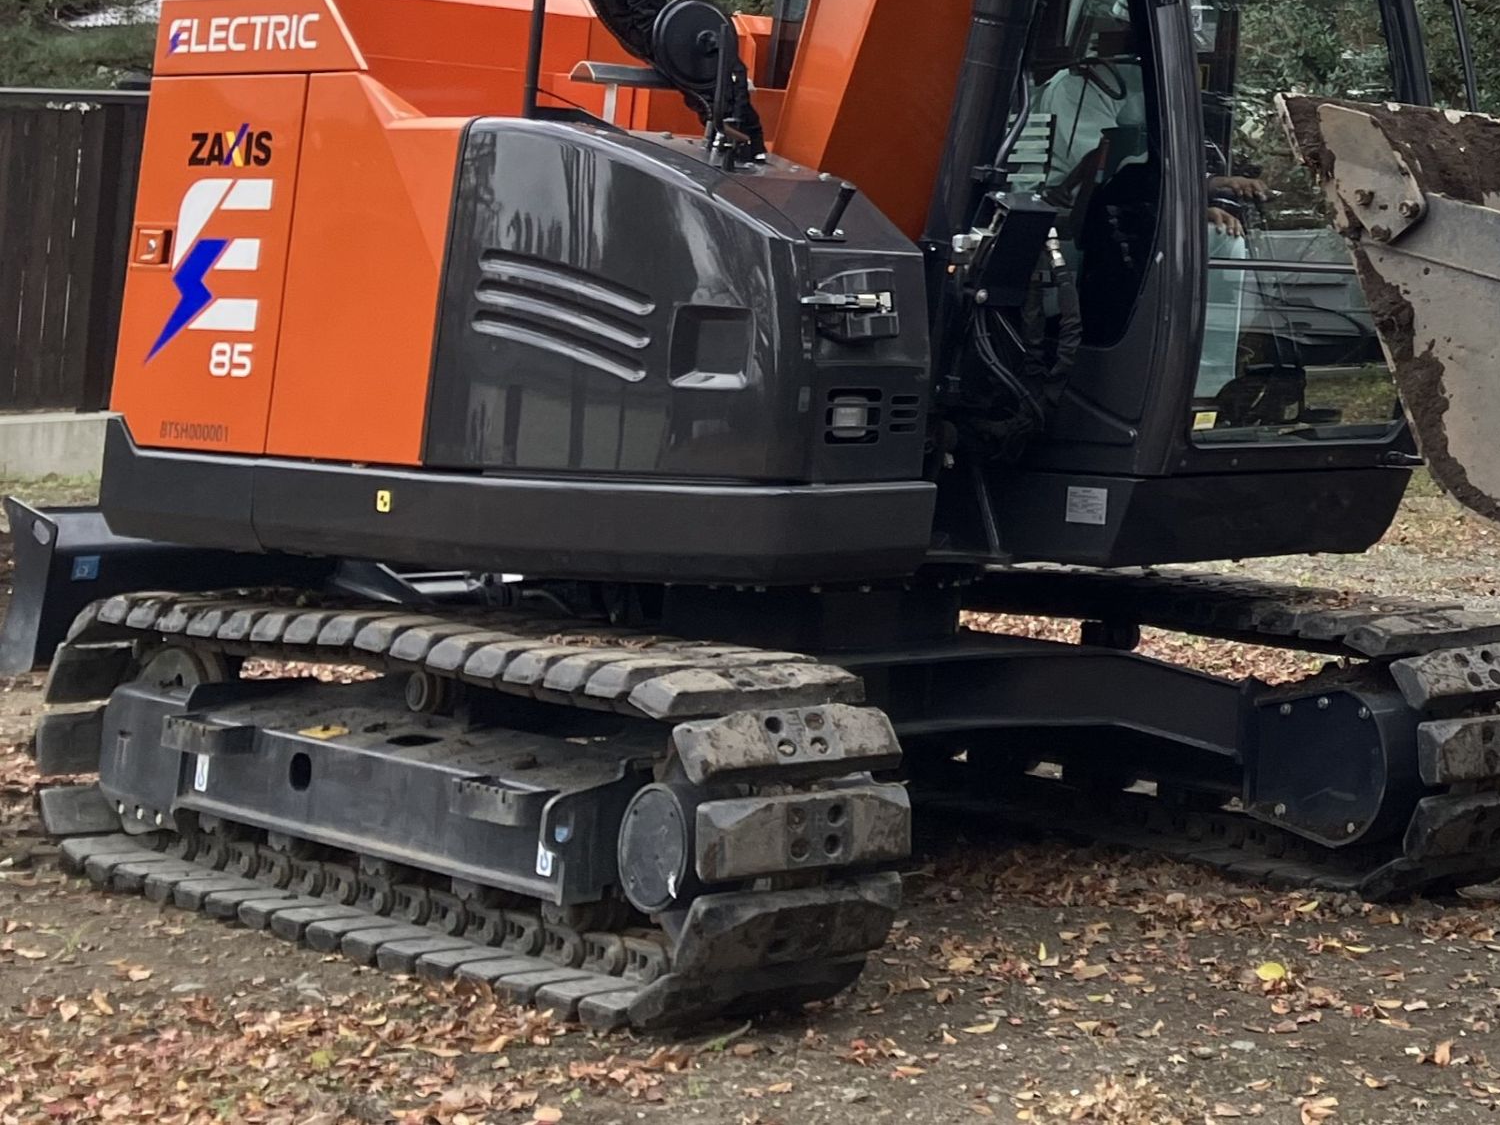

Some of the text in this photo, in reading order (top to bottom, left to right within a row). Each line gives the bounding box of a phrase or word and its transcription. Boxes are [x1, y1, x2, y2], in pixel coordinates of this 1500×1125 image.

[166, 13, 320, 57] ELECTRIC
[188, 122, 273, 167] ZAXIS
[209, 341, 253, 378] 85
